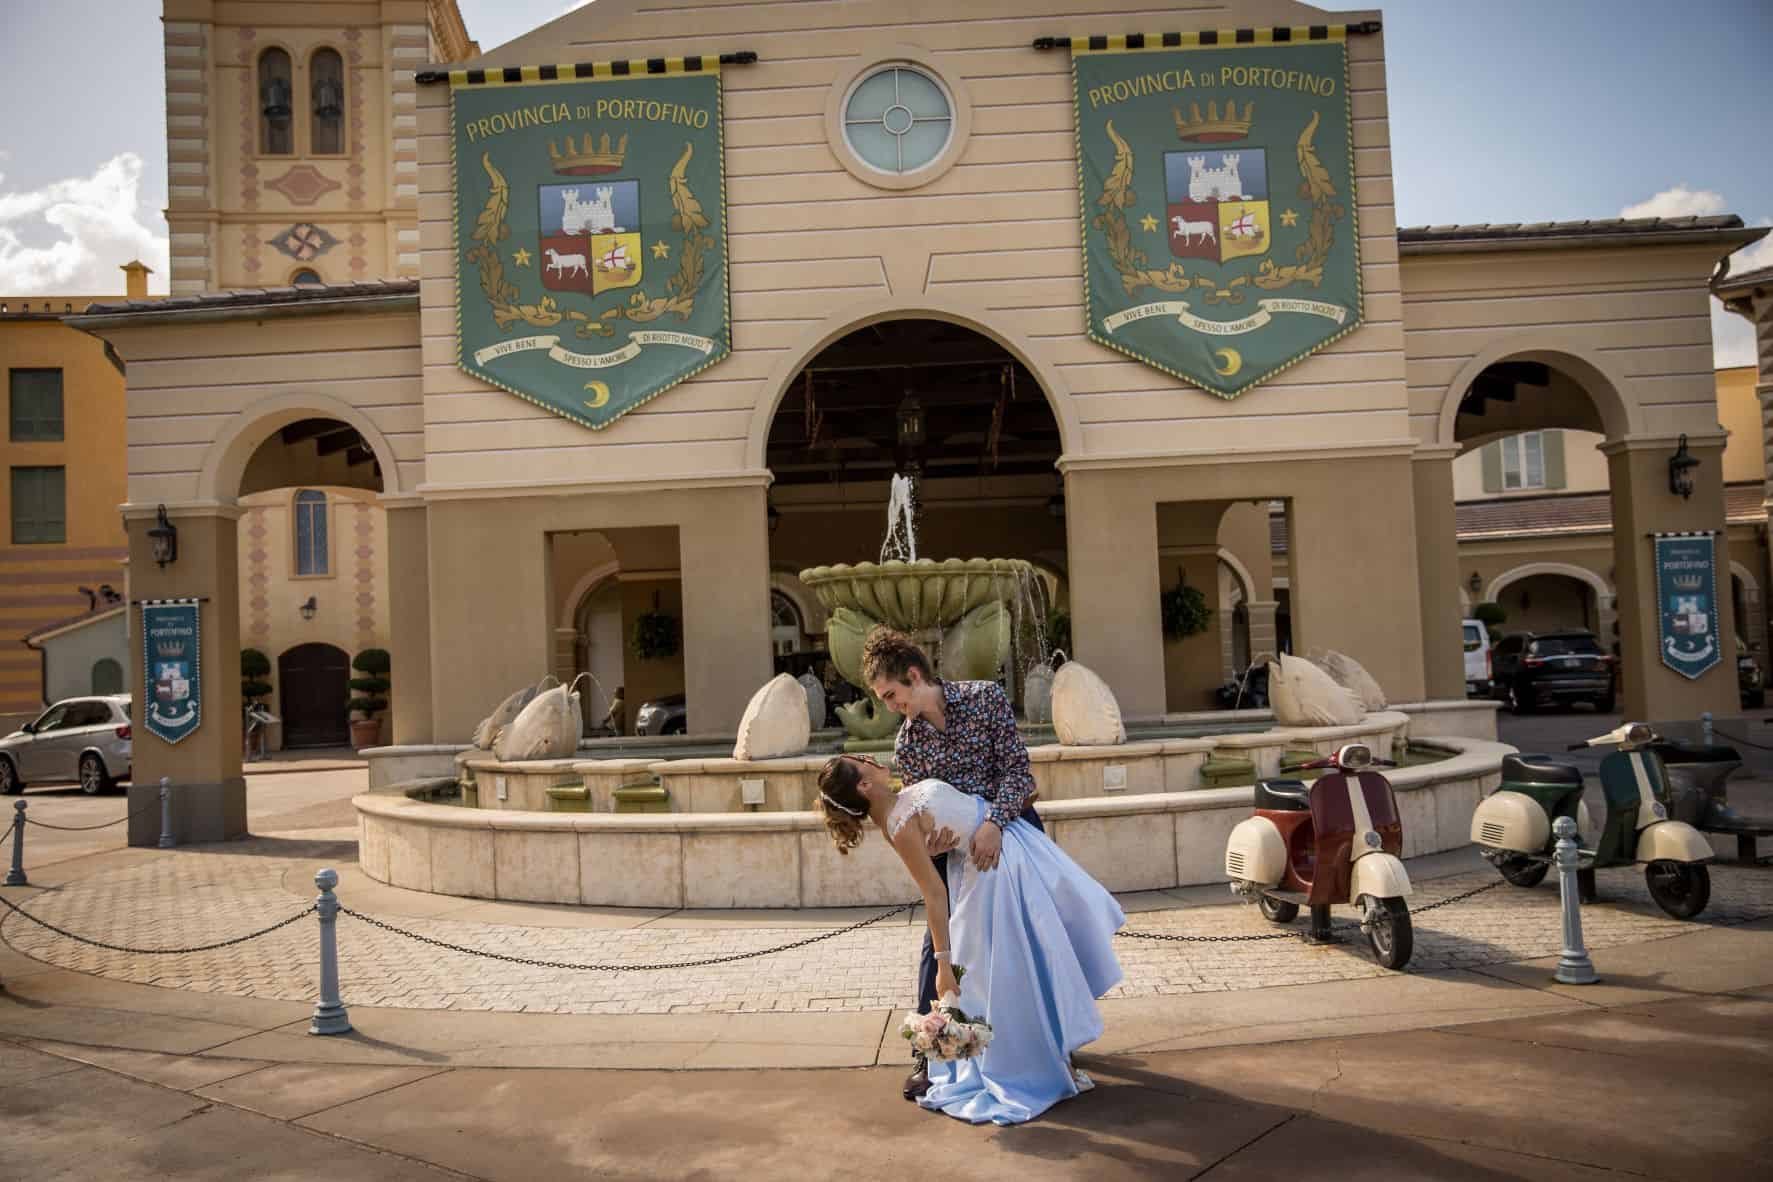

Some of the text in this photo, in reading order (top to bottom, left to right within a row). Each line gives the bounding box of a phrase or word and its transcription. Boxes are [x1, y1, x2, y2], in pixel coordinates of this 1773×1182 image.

[1088, 66, 1336, 109] PROVINCIA DI PORTOFINO
[465, 99, 709, 142] PROVINCIA DI PORTOFINO
[1123, 305, 1167, 321] VIVE BENE
[494, 338, 537, 355] VIVE BENE
[563, 352, 592, 367] SPESSO
